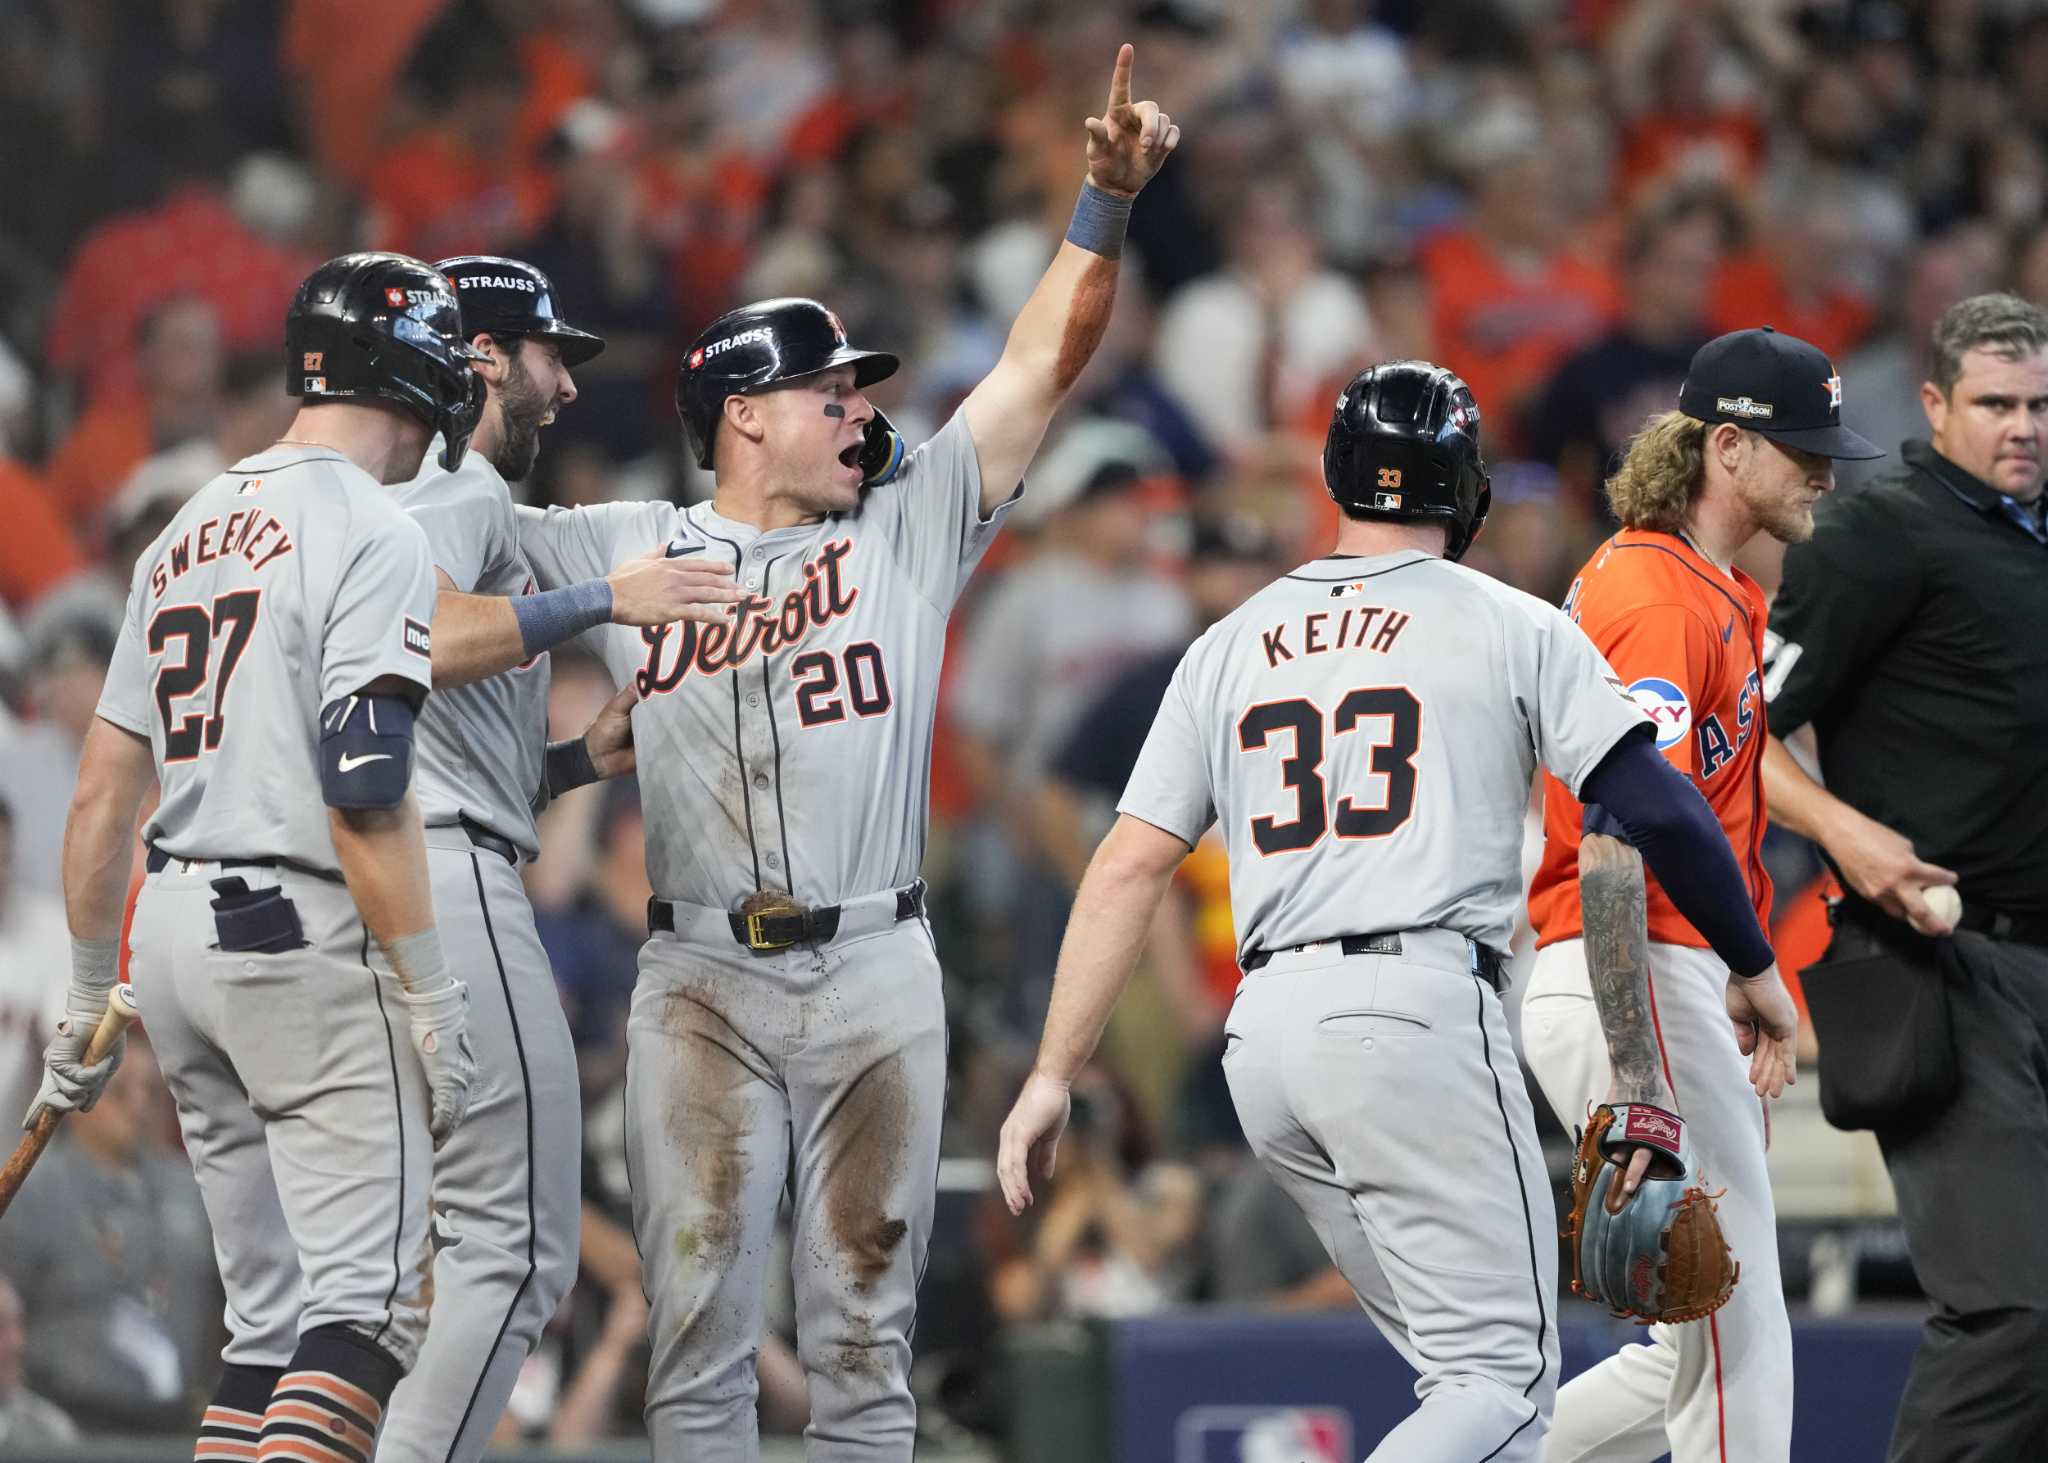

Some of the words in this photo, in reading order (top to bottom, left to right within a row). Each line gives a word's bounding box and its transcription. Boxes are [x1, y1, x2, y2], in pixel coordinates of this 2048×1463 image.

[406, 289, 458, 311] STRAUSS
[459, 276, 535, 293] STRAUSS
[303, 352, 323, 370] 27
[705, 327, 773, 358] STRAUSS
[1377, 468, 1401, 487] 33
[152, 507, 293, 599] SWEENEY
[636, 536, 860, 699] Detroit
[1261, 606, 1411, 669] KEITH
[147, 588, 262, 766] 27
[790, 640, 893, 730] 20
[1237, 685, 1424, 857] 33
